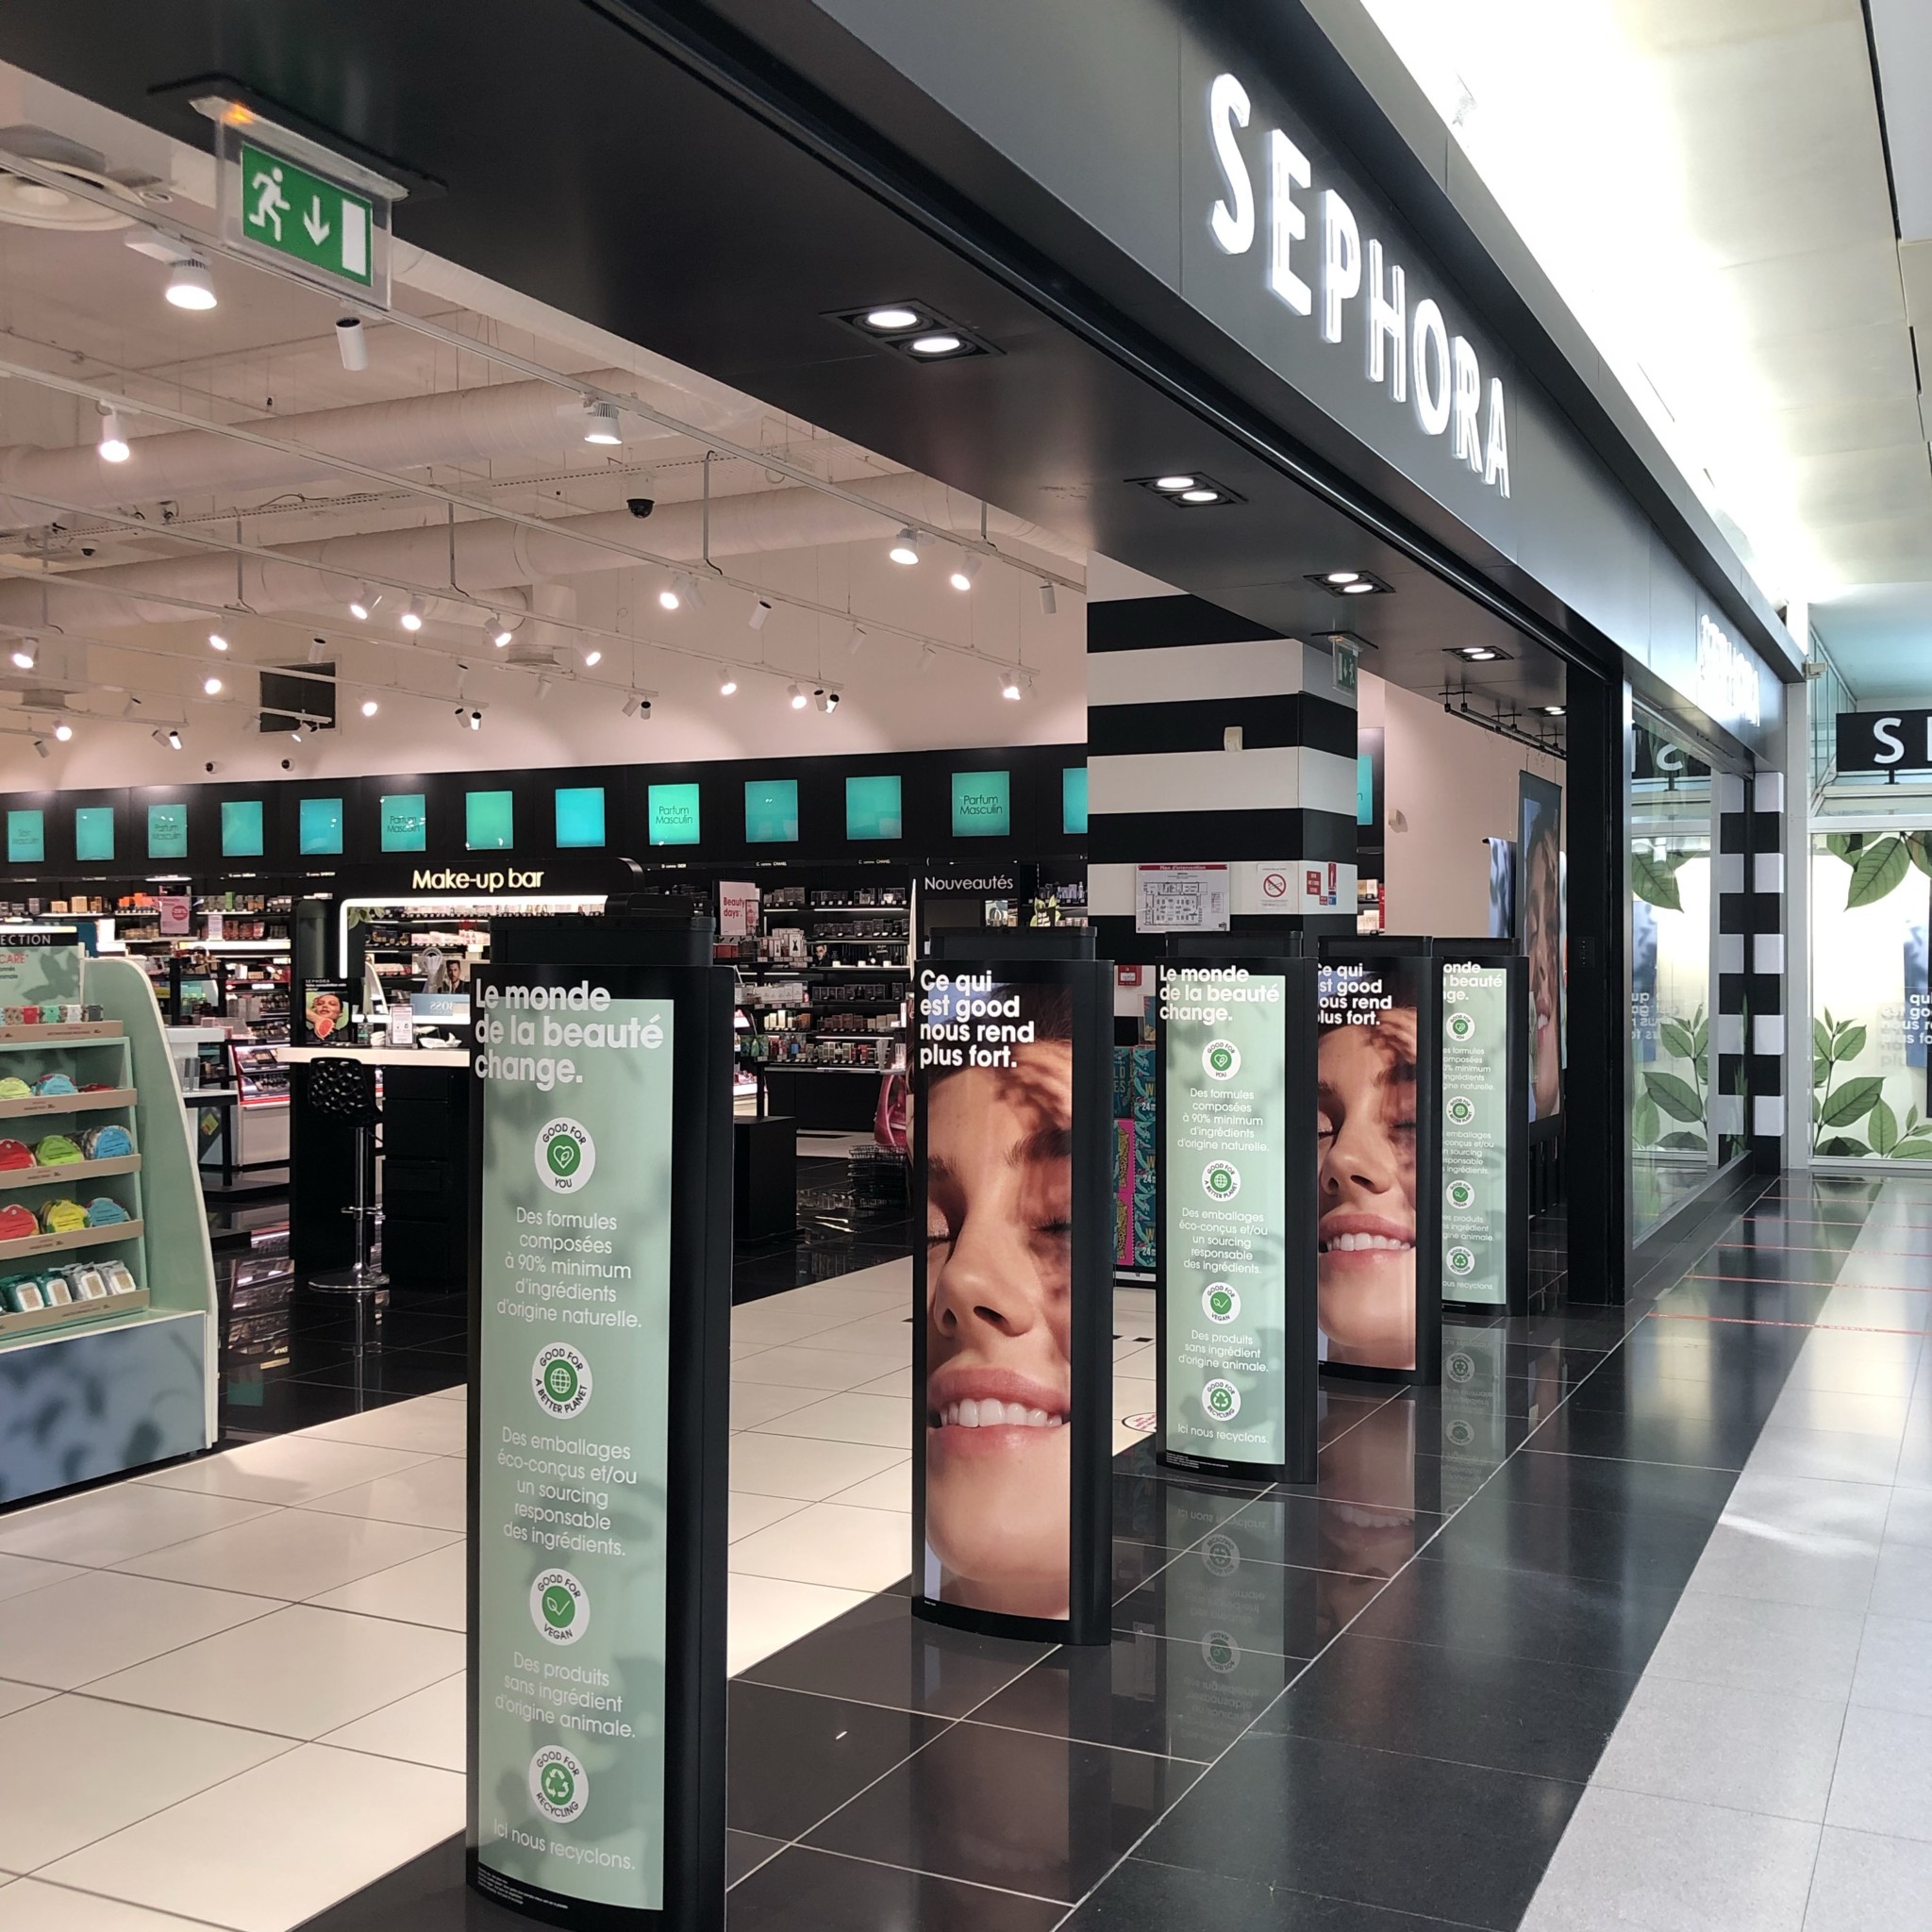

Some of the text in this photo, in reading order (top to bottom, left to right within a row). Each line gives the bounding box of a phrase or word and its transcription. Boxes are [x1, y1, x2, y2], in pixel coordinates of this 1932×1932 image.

[1208, 74, 1510, 499] SEPHORA
[964, 794, 998, 805] Parfum
[658, 806, 690, 815] Parfum
[959, 805, 1003, 815] Masculin
[656, 814, 693, 824] Masculin
[412, 868, 544, 892] Make-up bar
[924, 874, 1014, 891] Nouveautés
[724, 896, 745, 908] Beauty
[1159, 964, 1250, 983] Le monde
[1337, 963, 1363, 982] qui
[1443, 961, 1481, 974] onde
[920, 970, 992, 996] Ce qui
[1319, 979, 1382, 996] st good
[1449, 974, 1503, 988] beauté
[475, 978, 611, 1011] Le monde
[1159, 983, 1279, 1003] de la beauté
[920, 994, 1020, 1023] est good
[1319, 995, 1392, 1009] ous rend
[1159, 1004, 1233, 1026] change.
[1346, 1010, 1381, 1025] fort.
[475, 1013, 664, 1049] de la beauté
[920, 1021, 1035, 1042] nous rend
[920, 1044, 1018, 1069] plus fort.
[1207, 1042, 1236, 1055] GOOD FOR
[475, 1049, 583, 1091] change.
[1190, 1088, 1255, 1100] Des formules
[1192, 1102, 1253, 1113] composées
[1183, 1113, 1263, 1125] à 90% minimum
[542, 1123, 587, 1145] GOOD FOR
[1190, 1126, 1255, 1139] d'ingrédients
[1446, 1131, 1491, 1140] emballages
[1177, 1138, 1270, 1152] d'origine naturelle.
[1450, 1149, 1483, 1158] sourcing
[1207, 1163, 1236, 1175] GOOD FOR
[555, 1177, 573, 1189] YOU
[1206, 1185, 1223, 1199] BETTER
[1224, 1182, 1238, 1199] PLANET
[516, 1207, 617, 1230] Des formules
[1182, 1208, 1264, 1224] Des emballages
[1453, 1215, 1484, 1224] produits
[1179, 1220, 1268, 1236] éco-conçus et/ou
[1451, 1223, 1490, 1232] ingrédient
[520, 1234, 612, 1255] composées
[1192, 1236, 1252, 1249] un sourcing
[1191, 1247, 1253, 1260] responsable
[505, 1252, 631, 1279] à 90% minimum
[1184, 1258, 1262, 1274] des ingrédients.
[515, 1277, 617, 1303] d'ingrédients
[1207, 1285, 1236, 1298] GOOD FOR
[497, 1298, 641, 1328] d'origine naturelle.
[1211, 1312, 1230, 1322] VEGAN
[1191, 1330, 1253, 1345] Des produits
[1185, 1342, 1261, 1358] sans ingrédient
[540, 1348, 584, 1372] GOOD FOR
[1178, 1355, 1269, 1373] d'origine animale.
[535, 1377, 589, 1414] A BETTER PLANET
[1207, 1382, 1236, 1395] GOOD FOR
[1207, 1406, 1235, 1419] RECYCLING
[1177, 1424, 1269, 1443] Ici nous recyclons.
[502, 1426, 631, 1462] Des emballages
[498, 1448, 638, 1484] éco-conçus et/ou
[517, 1479, 608, 1510] un sourcing
[515, 1502, 611, 1531] responsable
[504, 1522, 625, 1557] des ingrédients.
[537, 1574, 582, 1599] GOOD FOR
[543, 1624, 574, 1640] VEGAN
[513, 1651, 610, 1687] Des produits
[504, 1674, 624, 1713] sans ingrédient
[495, 1694, 636, 1739] d'origine animale.
[536, 1751, 580, 1777] GOOD FOR
[536, 1792, 579, 1818] RECYCLING
[493, 1819, 636, 1870] Ici nous recyclons.
